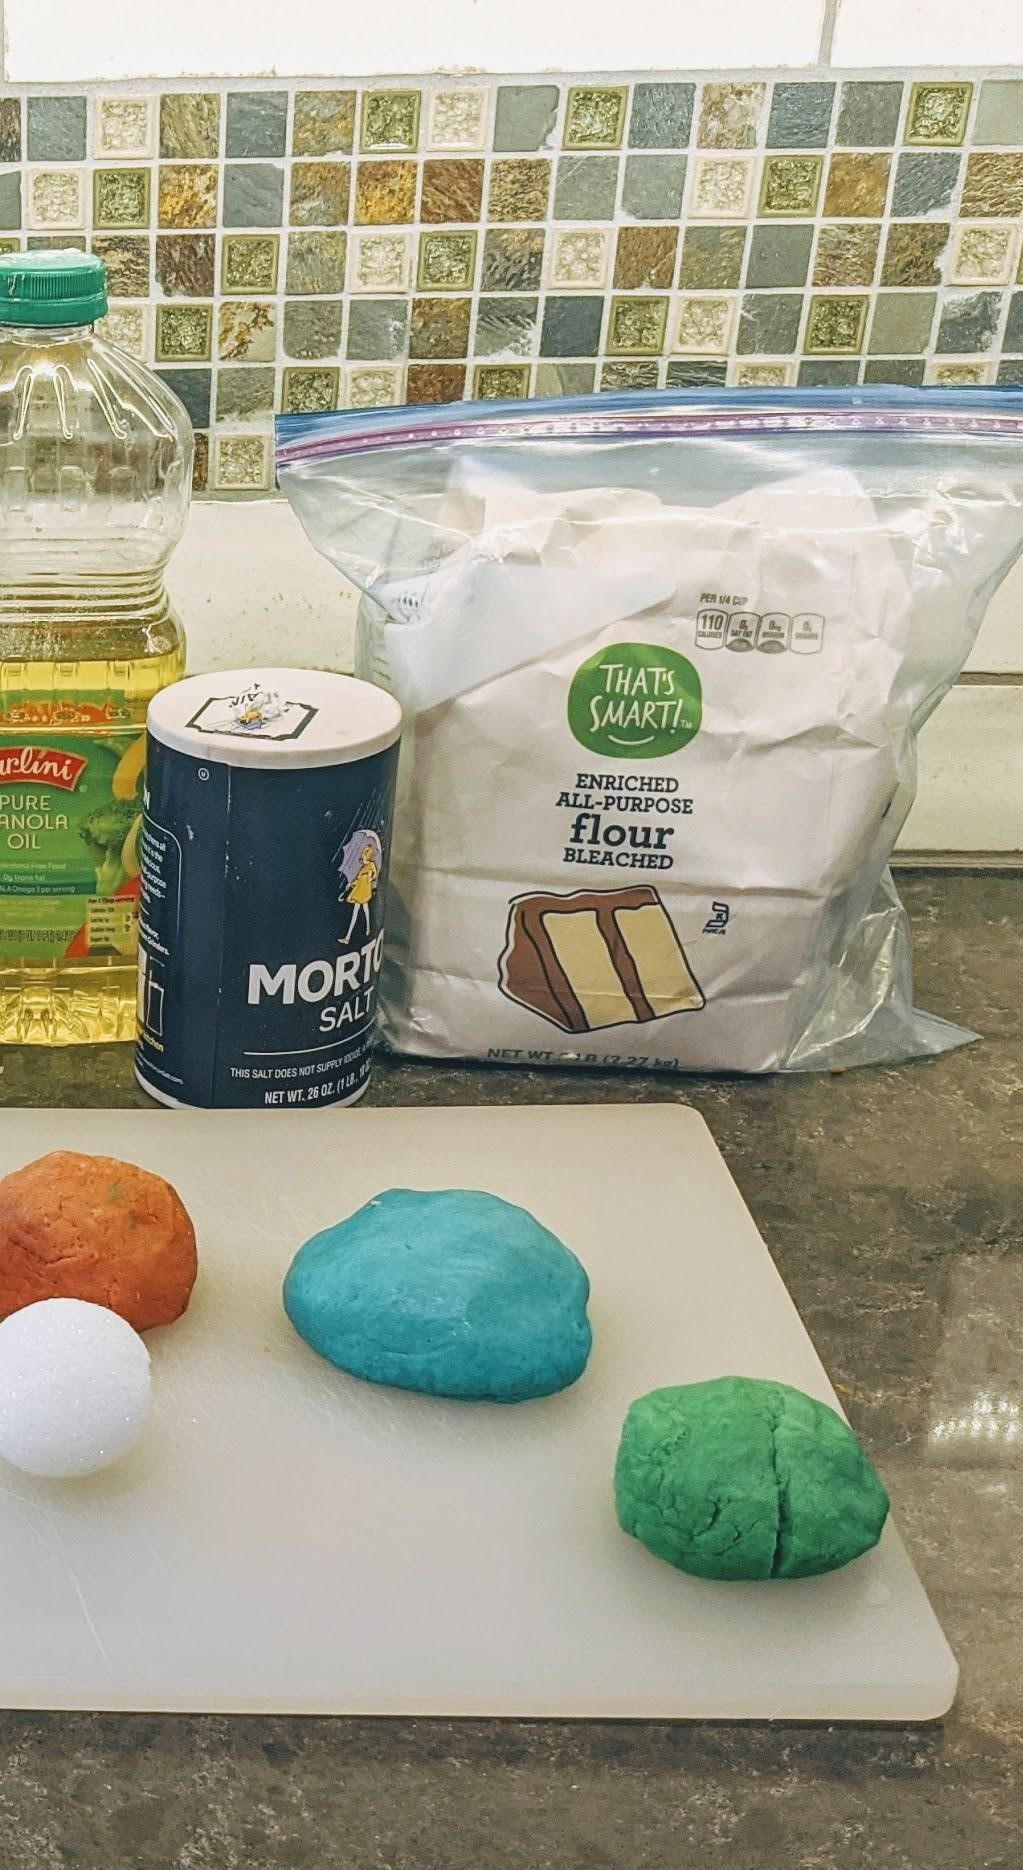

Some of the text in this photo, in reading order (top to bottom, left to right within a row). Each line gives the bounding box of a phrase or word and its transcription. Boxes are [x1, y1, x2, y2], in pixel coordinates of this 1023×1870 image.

[702, 613, 724, 630] 110
[599, 664, 675, 696] THAT'S
[590, 695, 683, 734] SMART!
[575, 773, 679, 793] ENRICHED
[0, 795, 51, 811] PURE
[556, 792, 693, 814] ALL-PURPOSE
[7, 833, 42, 850] OIL
[569, 812, 675, 849] flour
[563, 848, 674, 870] BLEACHED
[319, 985, 374, 1032] SALT
[487, 1048, 524, 1058] NET
[230, 1067, 250, 1078] THIS
[252, 1069, 273, 1079] SALT
[274, 1068, 297, 1079] DOES
[299, 1065, 316, 1076] NOT
[316, 1057, 343, 1073] SUPPLY
[265, 1091, 285, 1104] NET
[287, 1089, 305, 1103] WT.
[307, 1086, 319, 1100] 26
[321, 1082, 335, 1096] OZ.
